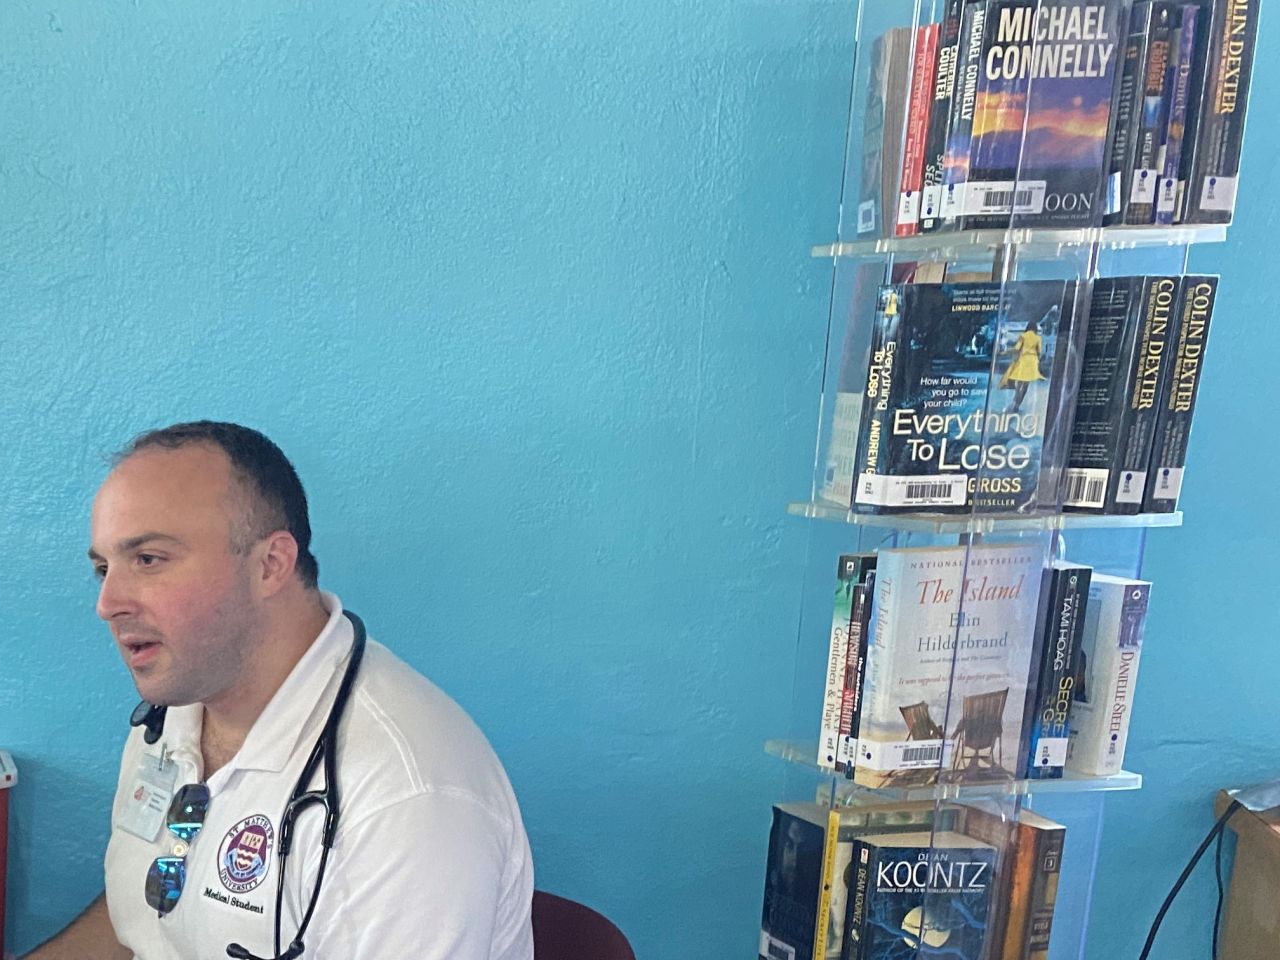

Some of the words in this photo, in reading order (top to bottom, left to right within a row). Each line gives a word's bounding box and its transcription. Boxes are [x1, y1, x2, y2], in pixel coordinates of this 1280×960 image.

[998, 6, 1109, 43] MICHAEL
[1231, 0, 1249, 35] LIN
[968, 10, 984, 61] MICHAEL
[935, 47, 950, 100] COULTER
[985, 43, 1114, 80] CONNELLY
[1220, 41, 1244, 114] DEXTER
[961, 65, 978, 120] CONNELLY
[1045, 193, 1094, 212] OON
[951, 304, 980, 312] LINWOOD
[1152, 280, 1174, 336] COLIN
[1188, 283, 1212, 339] COLIN
[873, 348, 886, 363] To
[867, 364, 883, 398] Lose
[877, 341, 896, 411] Everything
[920, 377, 938, 385] How
[940, 376, 951, 385] far
[952, 376, 978, 384] would
[1138, 341, 1165, 410] DEXTER
[1174, 344, 1202, 413] DEXTER
[923, 400, 941, 409] your
[943, 399, 967, 408] child?
[931, 389, 947, 398] you
[948, 389, 959, 397] go
[960, 387, 969, 395] to
[893, 408, 1039, 439] Everything
[865, 419, 881, 467] ANDREW
[907, 439, 934, 462] To
[938, 438, 1032, 470] Lose
[967, 477, 1022, 494] GROSS
[910, 559, 963, 569] NATIONAL
[970, 556, 1032, 567] BESTSELLER
[880, 577, 892, 604] The
[916, 578, 954, 605] The
[959, 574, 1025, 602] Island
[876, 607, 889, 649] Island
[949, 611, 981, 628] Elin
[1060, 597, 1072, 628] TAMI
[827, 627, 843, 686] Gentlemen
[917, 631, 1008, 652] Hilderbrand
[1053, 628, 1067, 671] HOAG
[1114, 651, 1135, 701] DANIELLE
[827, 690, 836, 698] &
[823, 703, 835, 730] Playe
[1110, 702, 1127, 737] STEEL
[220, 868, 258, 892] UNIVERSITY
[858, 868, 868, 892] DEAN
[876, 861, 989, 888] KOONTZ
[198, 887, 230, 905] Medical
[230, 896, 264, 914] Student
[852, 893, 864, 925] KOONTZ
